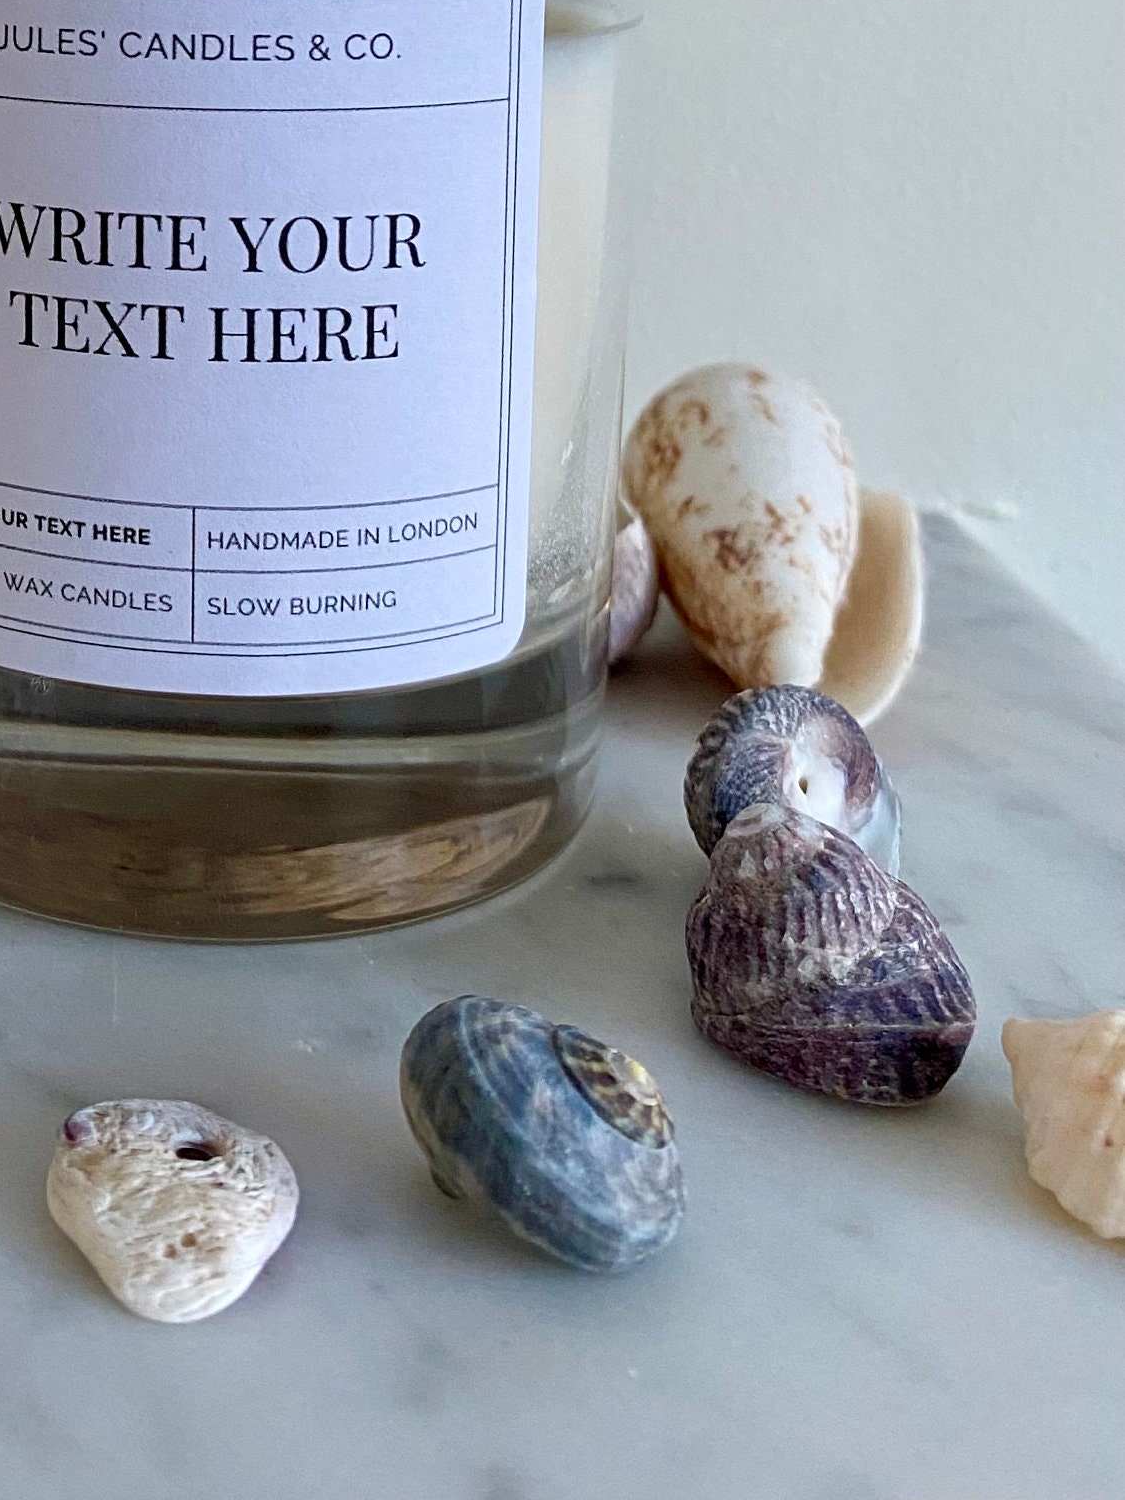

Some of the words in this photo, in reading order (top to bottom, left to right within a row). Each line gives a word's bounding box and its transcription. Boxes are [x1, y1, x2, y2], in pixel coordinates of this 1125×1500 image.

[119, 31, 295, 62] CANDLES
[308, 34, 332, 62] &
[344, 32, 401, 61] CO.
[228, 213, 427, 274] YOUR
[9, 290, 185, 361] TEXT
[207, 303, 399, 363] HERE
[33, 514, 87, 539] TEXT
[92, 523, 151, 546] HERE
[207, 529, 349, 551] HANDMADE
[357, 526, 380, 547] IN
[388, 512, 478, 544] LONDON
[3, 571, 53, 599] WAX
[60, 583, 173, 613] CANDLES
[207, 597, 281, 617] SLOW
[289, 590, 397, 616] BURNING
